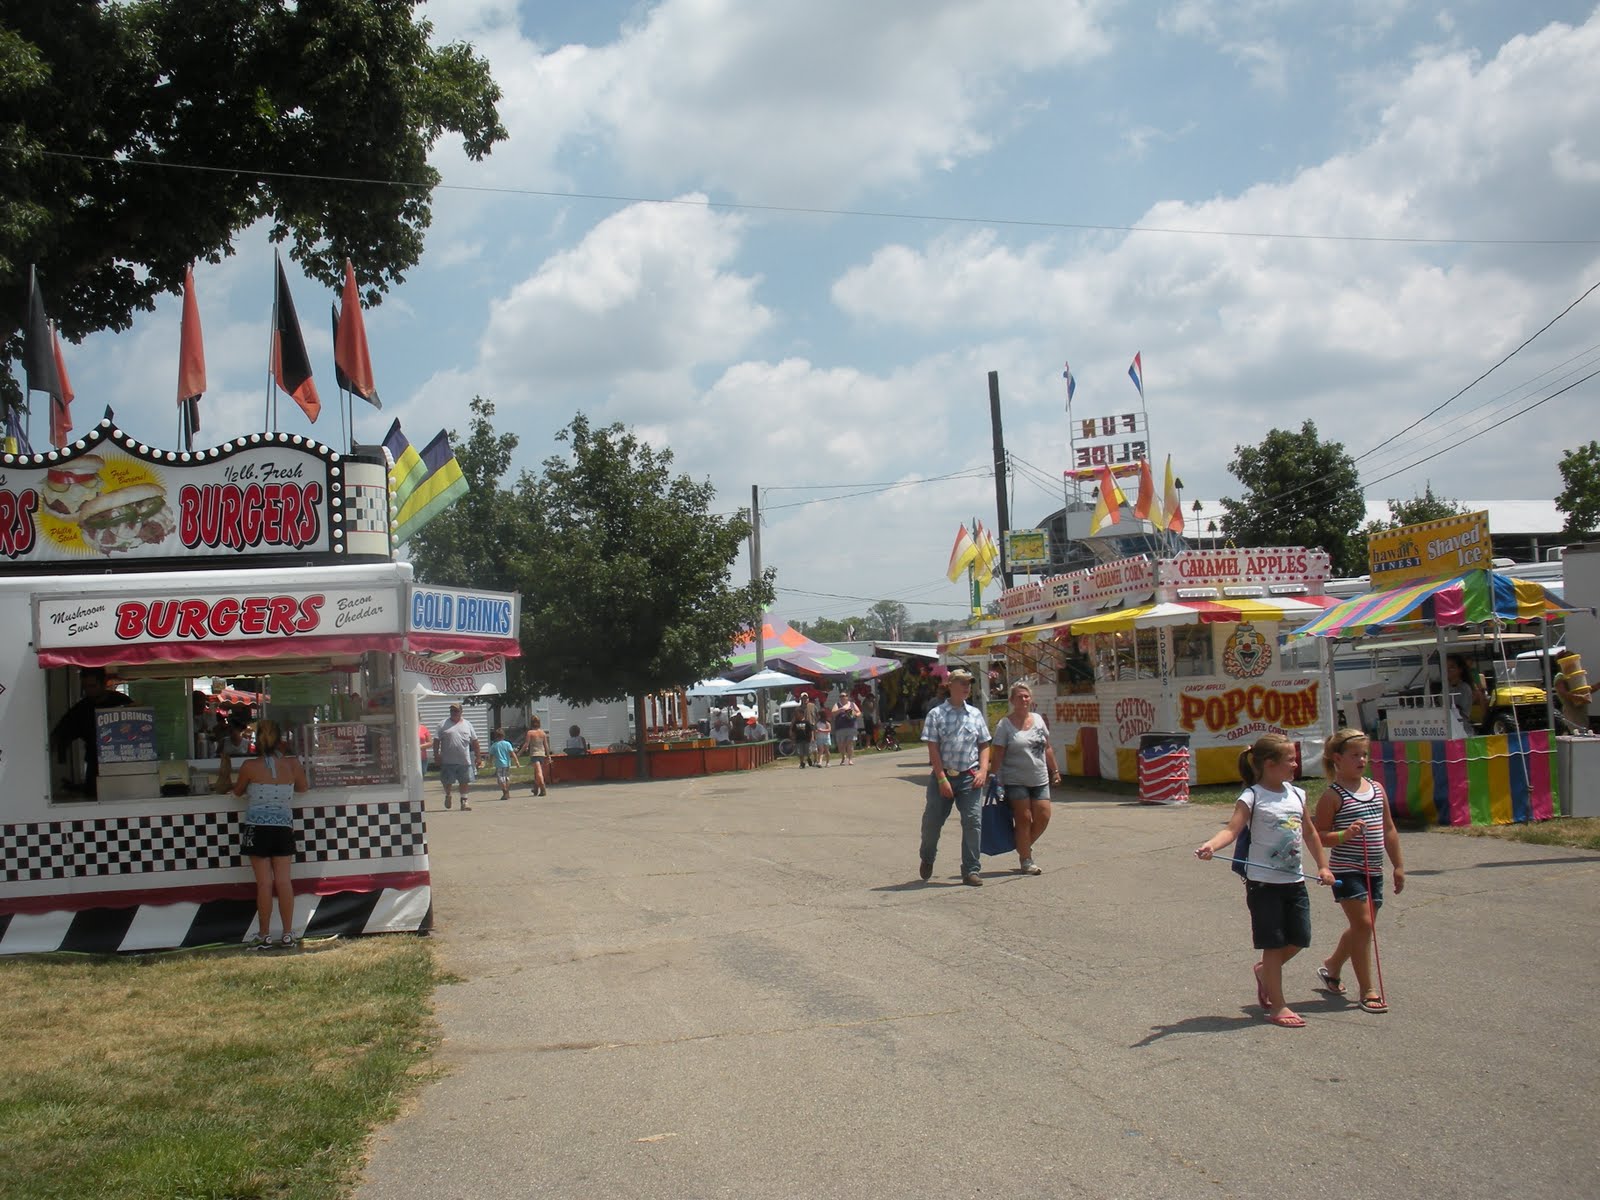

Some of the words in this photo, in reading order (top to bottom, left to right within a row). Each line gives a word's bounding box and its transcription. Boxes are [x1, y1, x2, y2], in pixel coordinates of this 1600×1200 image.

[260, 462, 304, 482] Fresh
[179, 481, 323, 552] BURGERS
[1427, 524, 1480, 560] Shaved
[1178, 557, 1241, 578] CARAMEL
[1245, 554, 1308, 575] APPLES
[1373, 558, 1420, 572] FINEST
[1457, 546, 1482, 568] Ice
[1124, 563, 1145, 582] CORN
[1053, 583, 1069, 598] PEPSI
[337, 595, 372, 611] Bacon
[412, 590, 454, 631] COLD
[456, 595, 512, 635] DRINKS
[50, 604, 106, 625] Mushroom
[115, 594, 326, 640] BURGERS
[335, 604, 384, 628] Cheddar
[68, 620, 99, 636] Swiss
[1160, 644, 1168, 686] DRINKS
[429, 676, 479, 694] BURGER
[1115, 698, 1156, 724] COTTON
[1179, 680, 1320, 733] POPCORN
[98, 712, 120, 726] COLD
[121, 711, 152, 722] DRINKS
[337, 724, 367, 737] MENU
[1118, 717, 1152, 744] CANDY
[1226, 722, 1268, 741] CARAMEL
